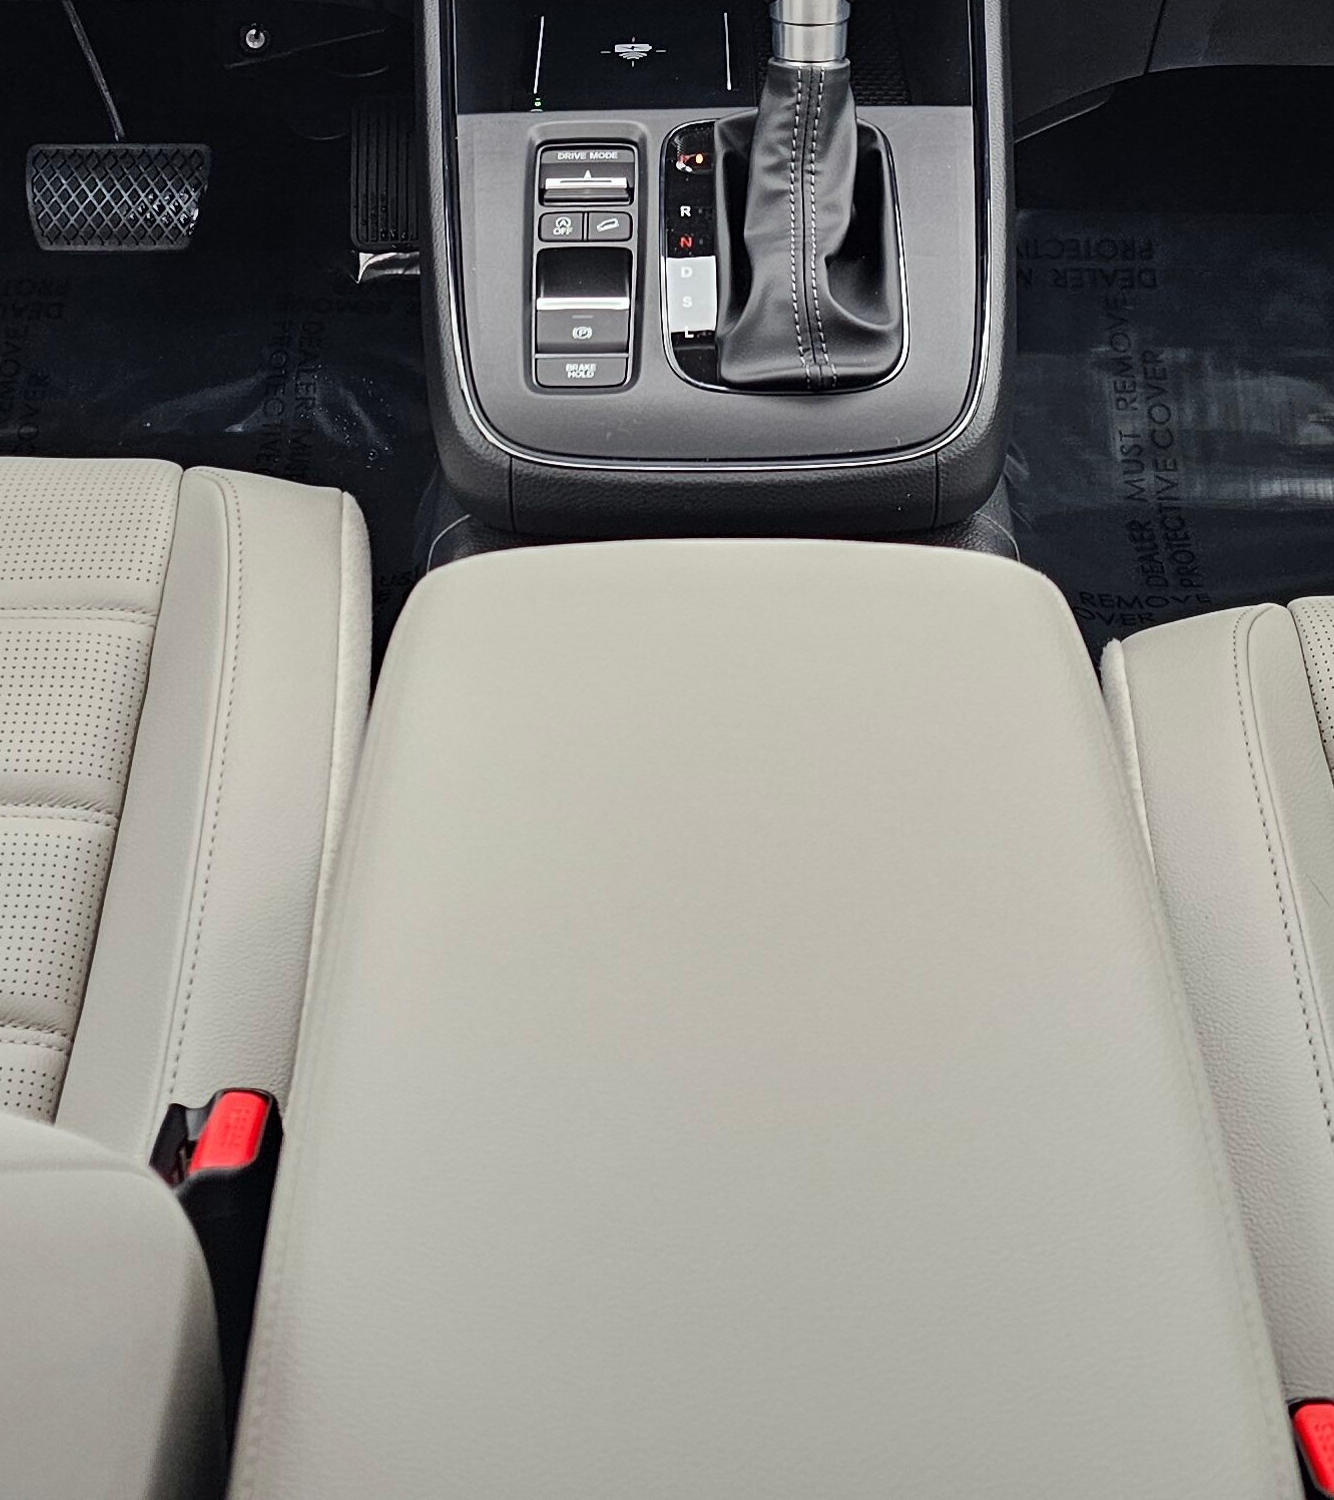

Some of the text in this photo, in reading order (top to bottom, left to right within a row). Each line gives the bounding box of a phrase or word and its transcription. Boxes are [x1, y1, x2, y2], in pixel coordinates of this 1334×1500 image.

[557, 151, 618, 160] DRIVE MODE
[680, 206, 691, 217] R
[553, 228, 573, 236] OFF
[680, 237, 692, 247] N
[680, 267, 693, 278] D
[682, 296, 693, 308] S
[684, 327, 694, 339] L
[566, 363, 597, 372] BRAKE
[567, 370, 595, 379] HOLD
[1141, 348, 1176, 451] COVER
[1118, 427, 1149, 503] MUST
[1072, 606, 1156, 626] OVER
